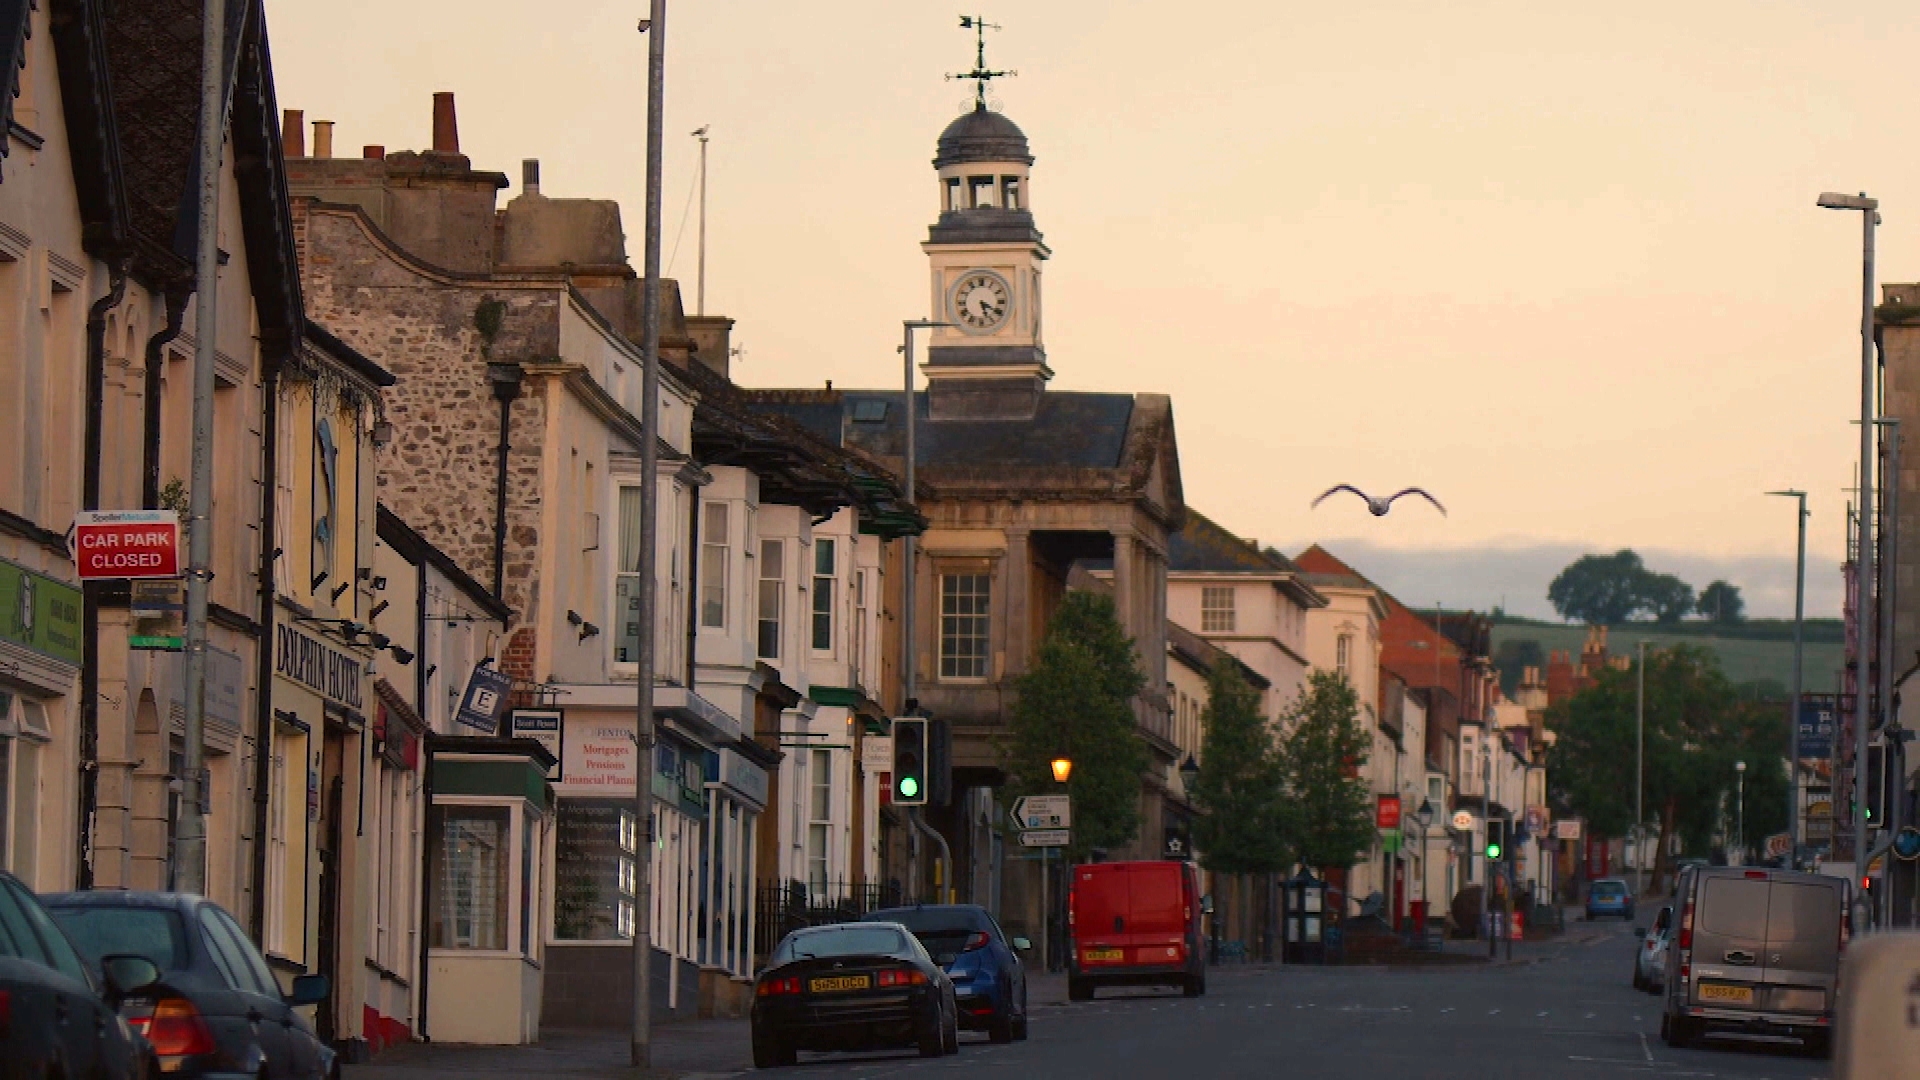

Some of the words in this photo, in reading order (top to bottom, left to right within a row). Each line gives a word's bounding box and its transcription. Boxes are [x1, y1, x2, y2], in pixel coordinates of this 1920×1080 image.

[83, 533, 119, 548] CAR
[124, 532, 170, 547] PARK
[91, 553, 162, 568] CLOSED
[277, 622, 325, 692] DOLPHIN
[328, 649, 362, 708] HOTEL
[597, 727, 634, 737] FENTON
[583, 743, 629, 757] Mortgages
[586, 760, 625, 769] Pensions
[564, 773, 604, 785] Financial
[607, 773, 635, 785] Planni
